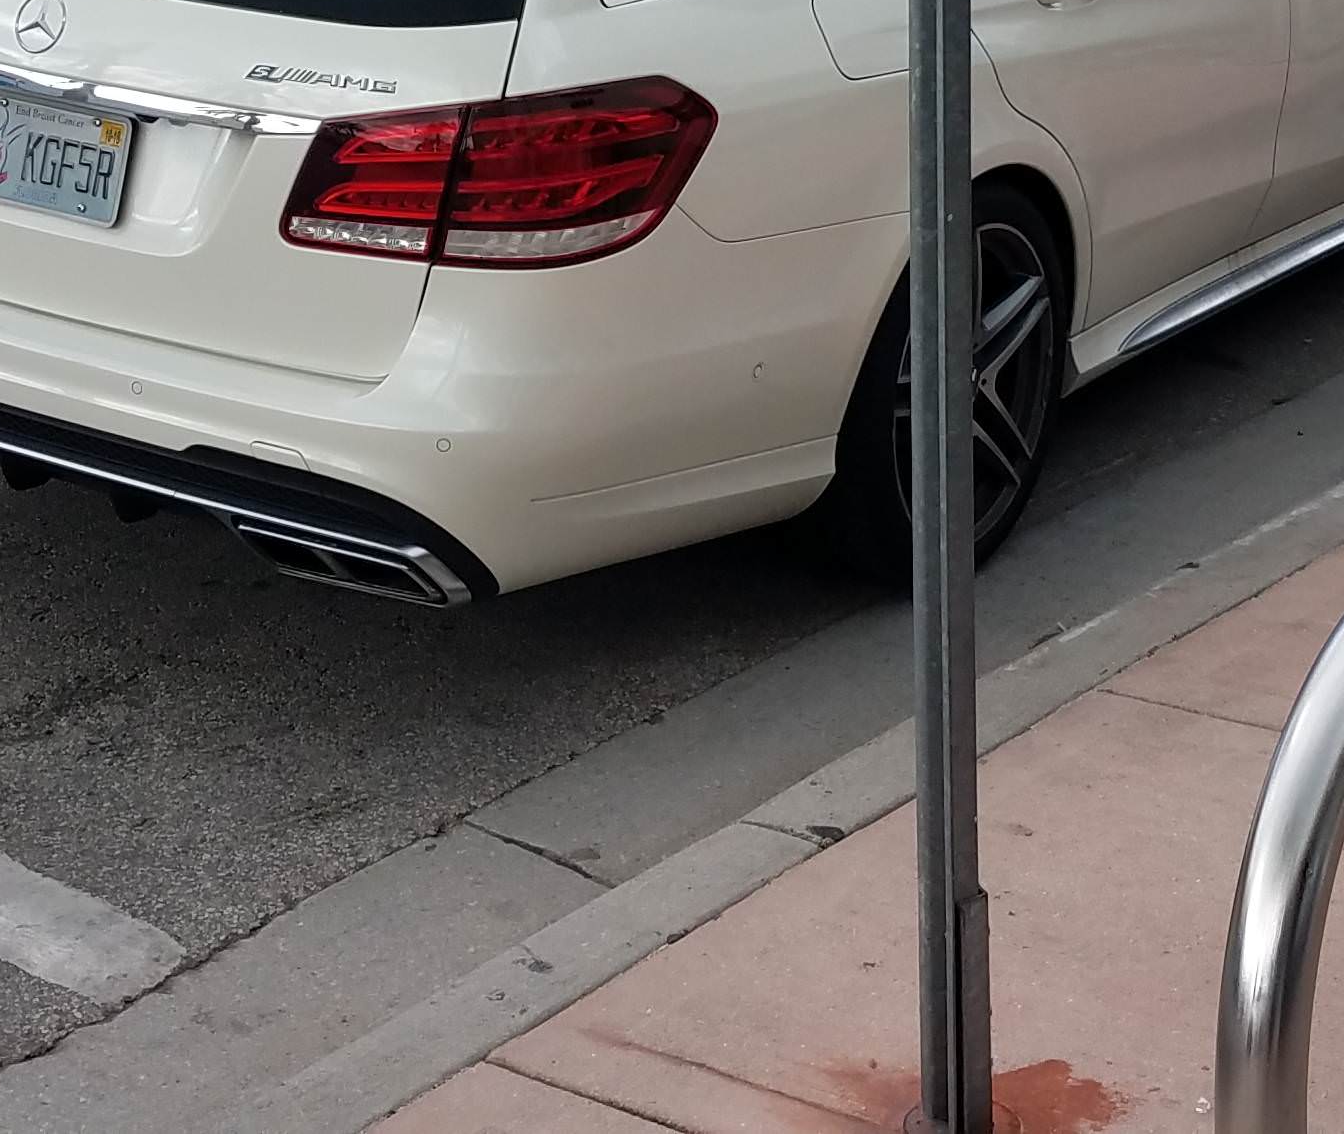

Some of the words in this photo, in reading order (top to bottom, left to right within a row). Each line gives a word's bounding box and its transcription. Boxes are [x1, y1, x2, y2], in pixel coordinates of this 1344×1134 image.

[15, 104, 31, 117] End
[32, 107, 56, 123] Breast
[57, 114, 85, 128] Cancer
